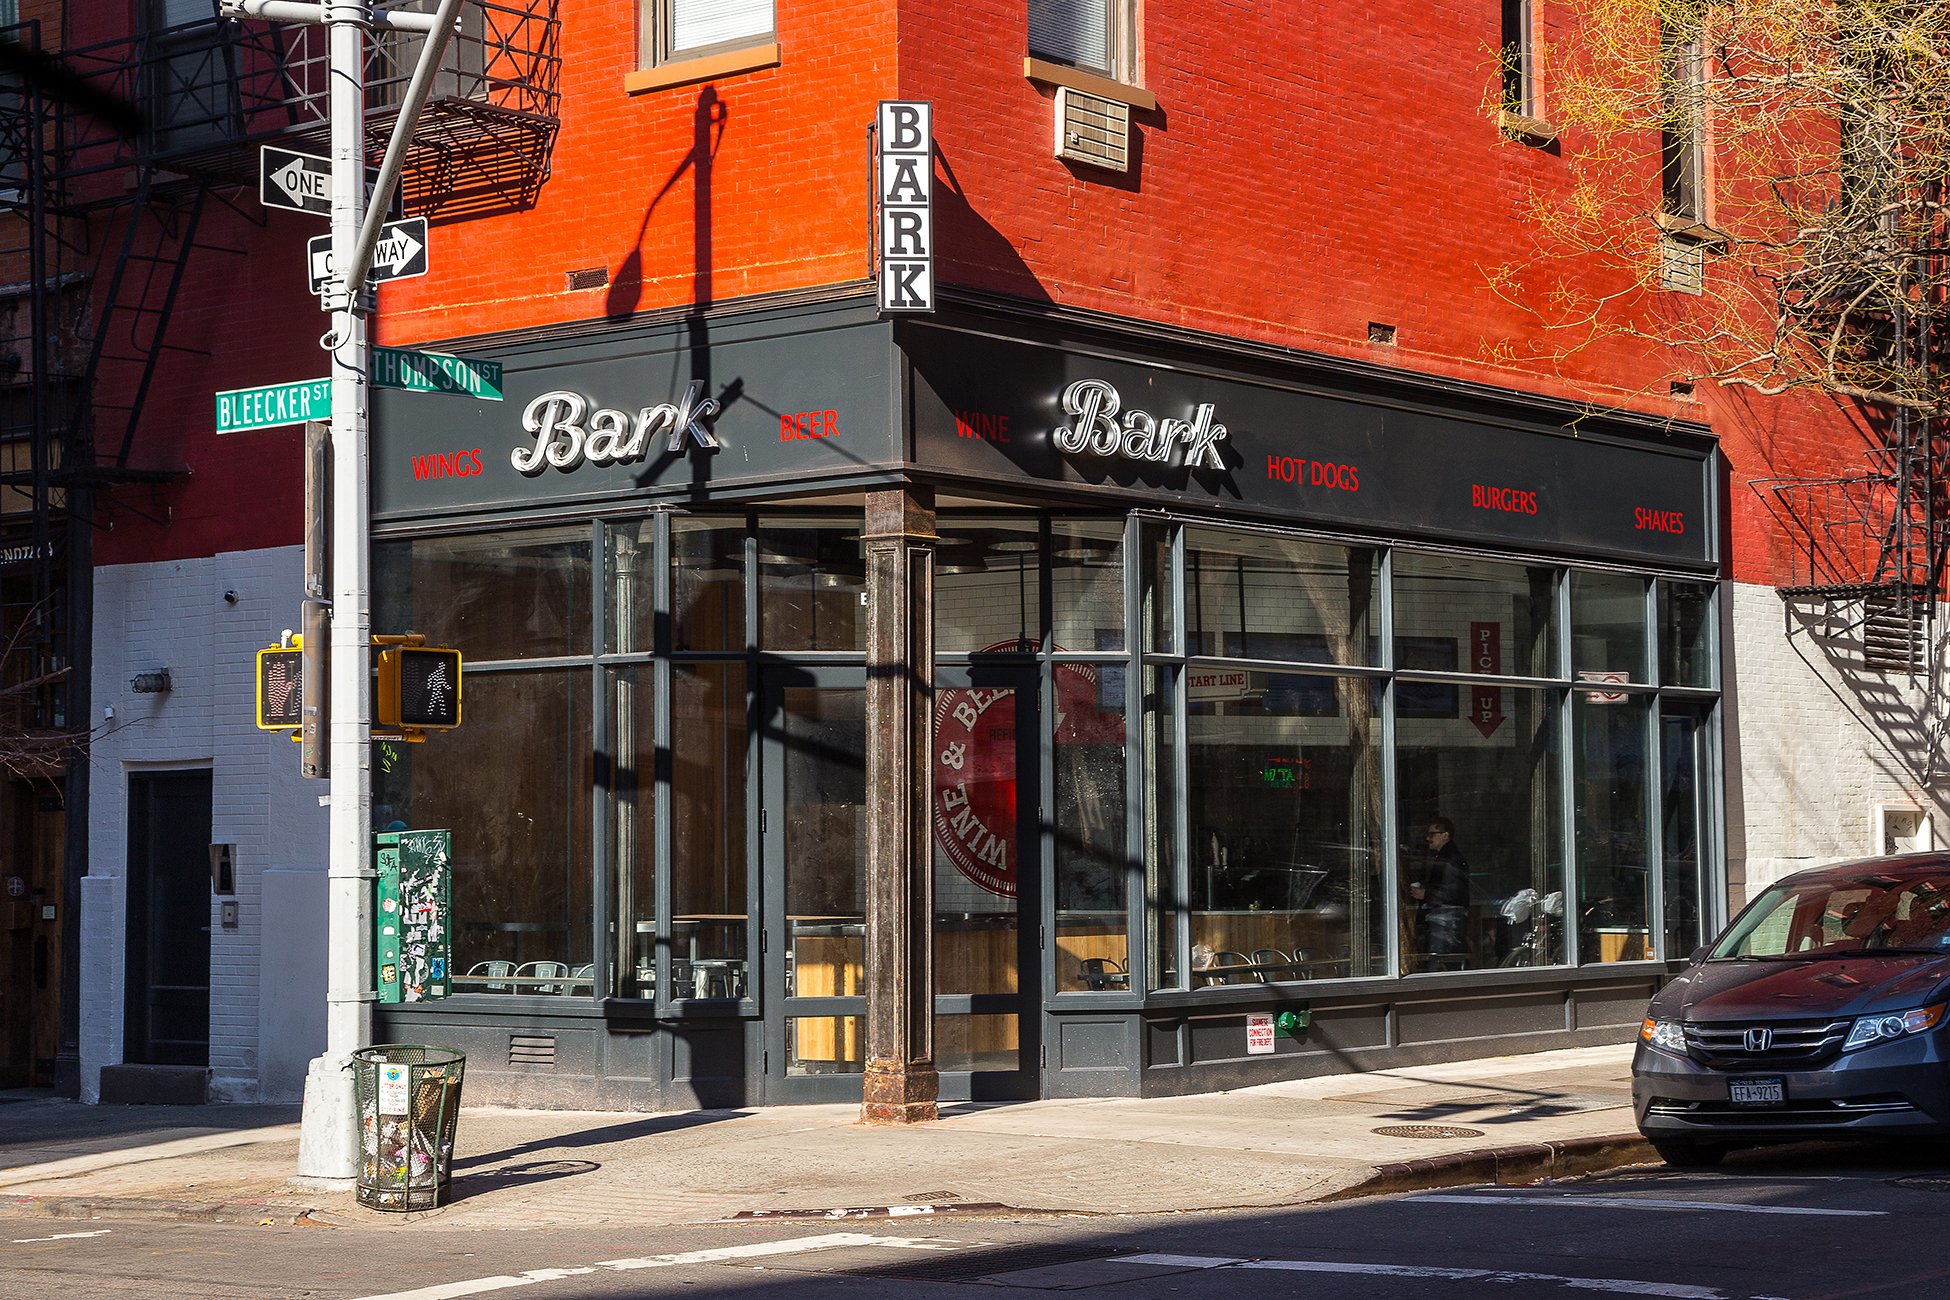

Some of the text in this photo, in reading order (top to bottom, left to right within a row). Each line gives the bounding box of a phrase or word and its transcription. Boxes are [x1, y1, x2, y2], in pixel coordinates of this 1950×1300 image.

[285, 170, 325, 196] ONE
[886, 105, 927, 308] BARK
[376, 239, 409, 264] WAY
[372, 351, 499, 393] THOMPSON ST
[220, 382, 329, 427] BLEECKER ST
[510, 379, 721, 473] Bark
[780, 409, 840, 442] BEER
[955, 409, 1010, 443] WINE
[1053, 378, 1228, 470] Bark
[412, 448, 483, 481] WINGS
[1267, 455, 1359, 491] HOT DOGS
[1472, 484, 1537, 515] BURGERS
[1635, 507, 1684, 534] SHAKES
[1188, 673, 1245, 688] TART LINE
[1479, 629, 1493, 722] PIC UP
[941, 741, 966, 770] &
[942, 782, 1007, 871] WINE
[1734, 1085, 1780, 1101] EFA 9215
